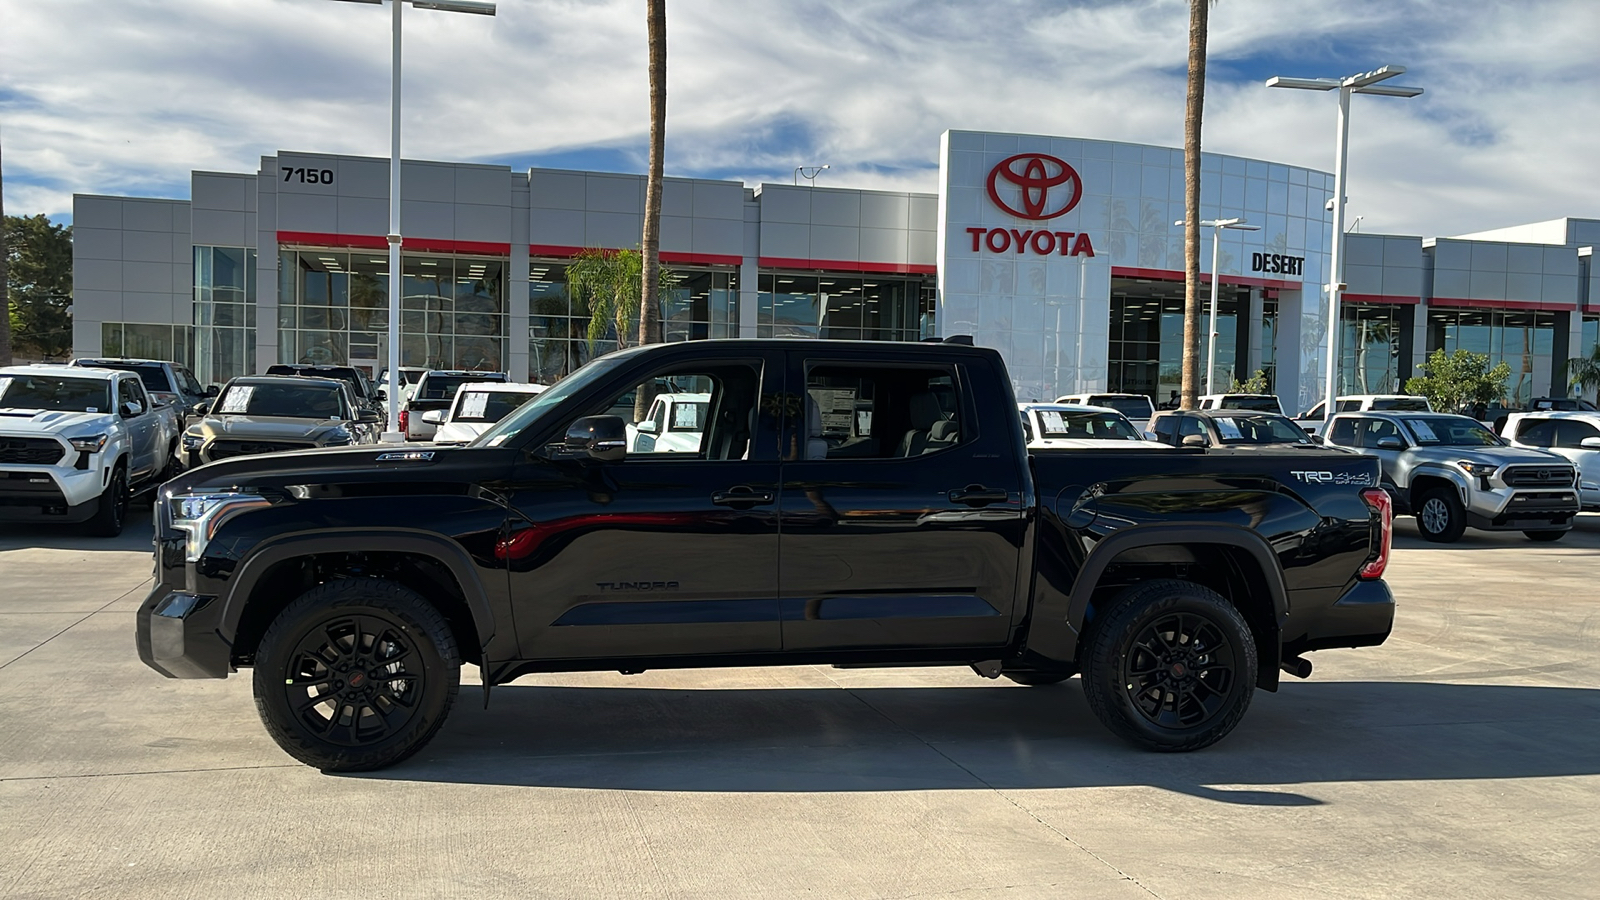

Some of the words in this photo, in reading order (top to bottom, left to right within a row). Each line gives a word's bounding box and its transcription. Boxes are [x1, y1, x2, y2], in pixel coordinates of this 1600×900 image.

[281, 166, 334, 185] 7150
[966, 227, 1095, 258] TOYOTA
[1252, 252, 1305, 276] DESERT
[1290, 470, 1333, 483] TRD
[595, 581, 680, 592] TUNDRA
